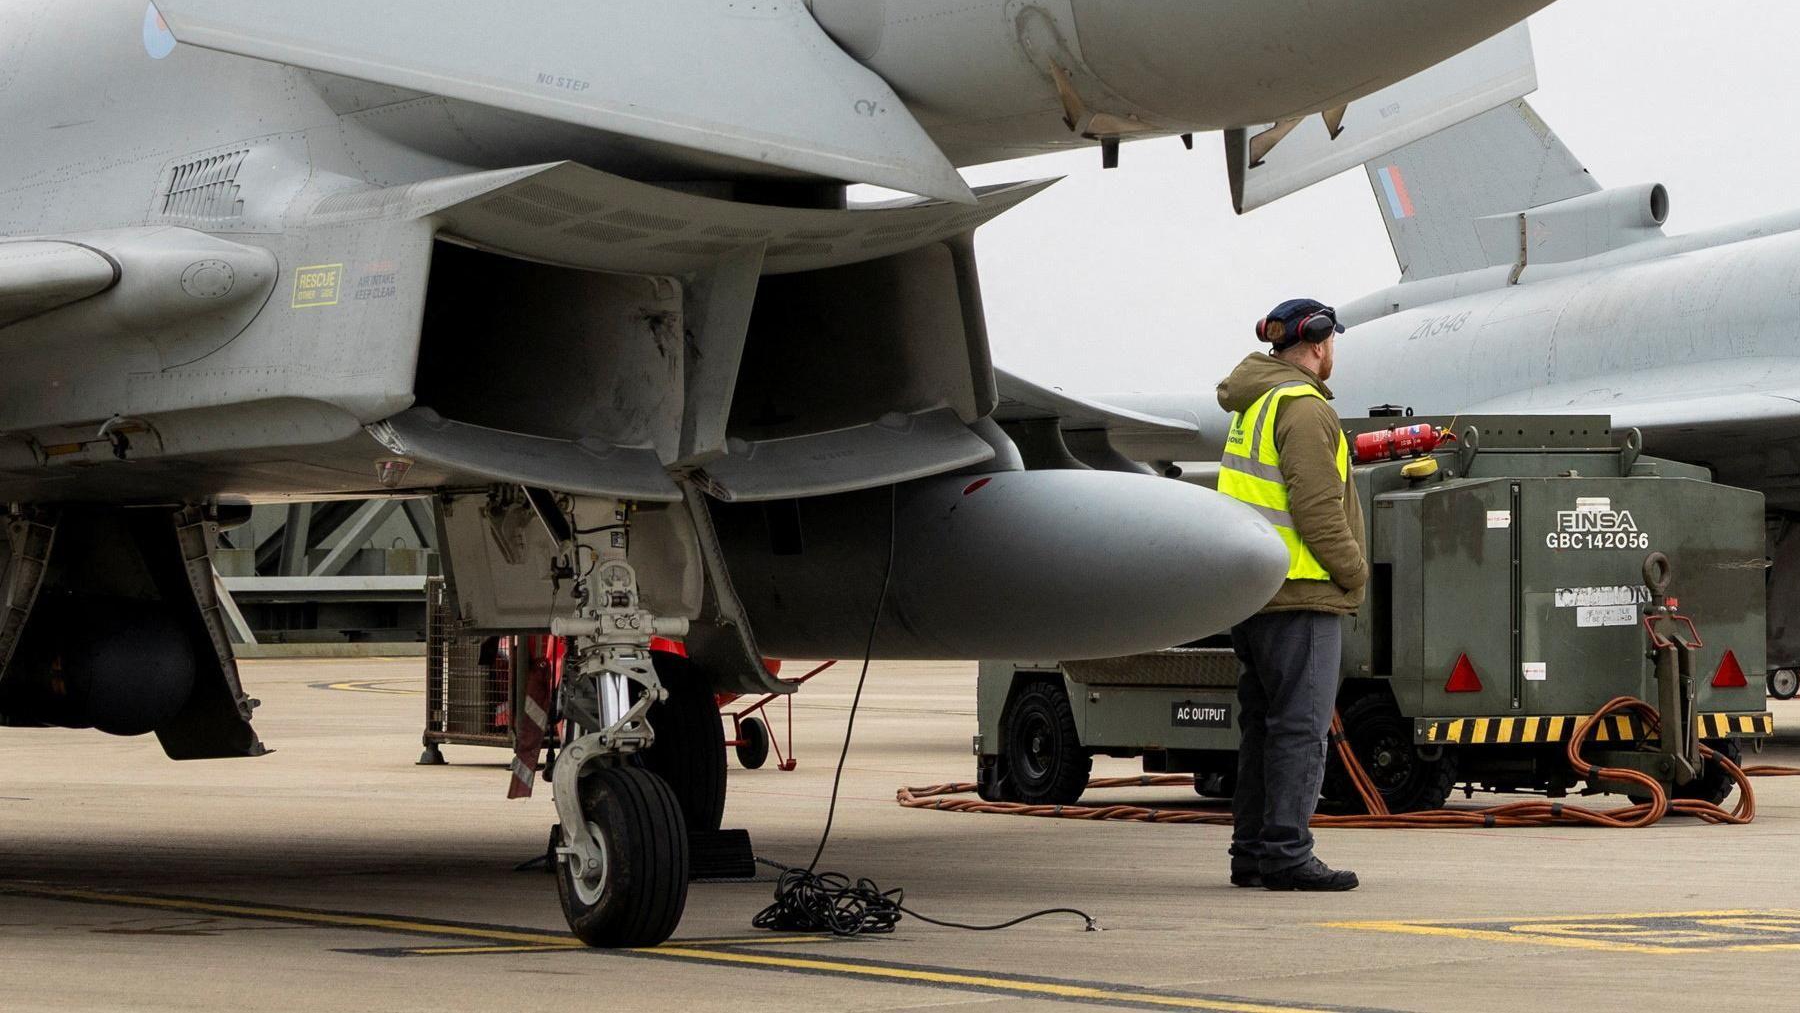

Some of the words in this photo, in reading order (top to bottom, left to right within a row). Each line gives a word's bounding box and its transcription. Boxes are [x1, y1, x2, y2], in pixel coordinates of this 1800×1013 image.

[536, 73, 554, 85] NO
[556, 77, 590, 91] STEP
[299, 271, 337, 287] RESCUE
[1557, 510, 1638, 532] EINSA
[1177, 707, 1190, 720] AC
[1192, 707, 1226, 721] OUTPUT
